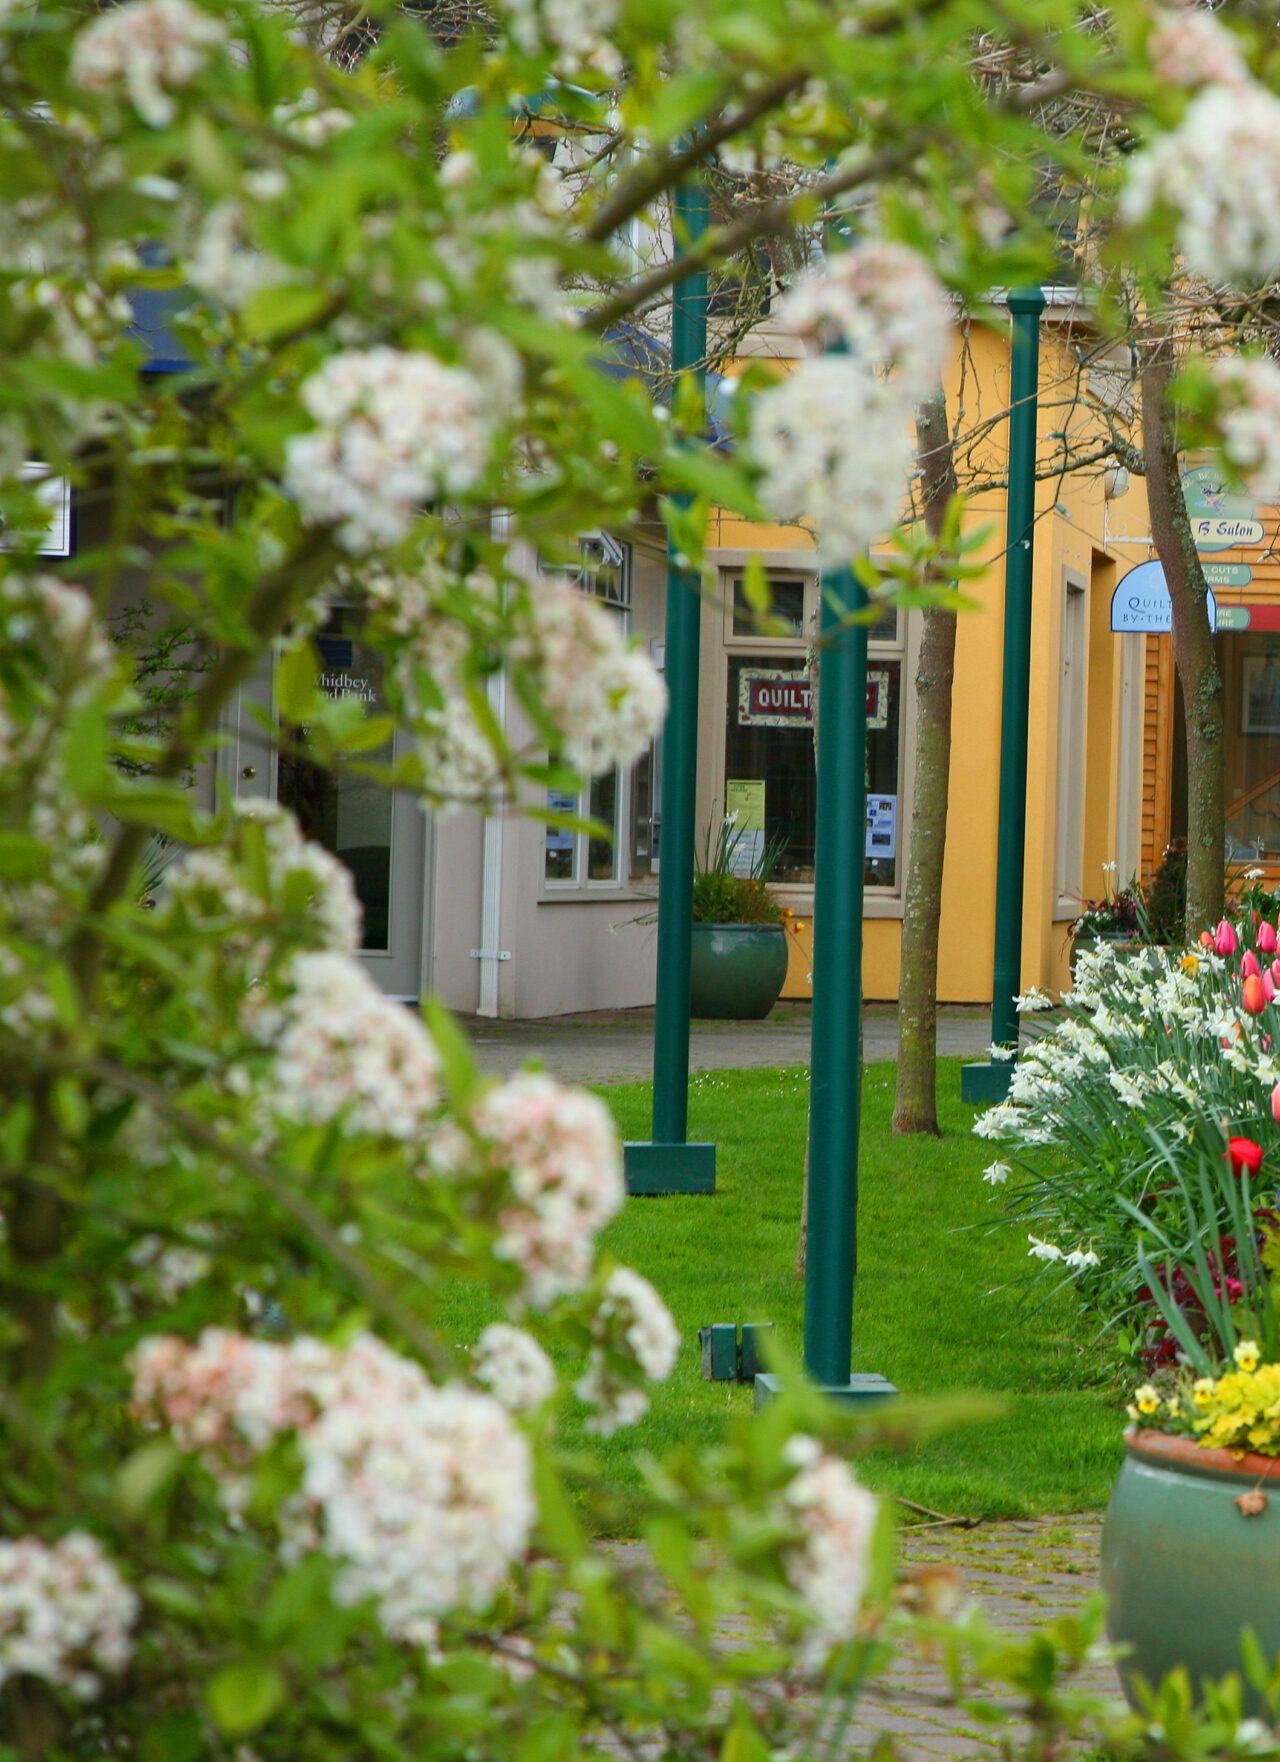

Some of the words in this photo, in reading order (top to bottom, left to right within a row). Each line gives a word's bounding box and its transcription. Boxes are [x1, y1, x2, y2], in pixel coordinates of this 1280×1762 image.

[1216, 521, 1253, 536] Salon
[1211, 565, 1239, 574] CUTS
[1128, 597, 1172, 614] QUILT
[758, 689, 813, 708] QUILT
